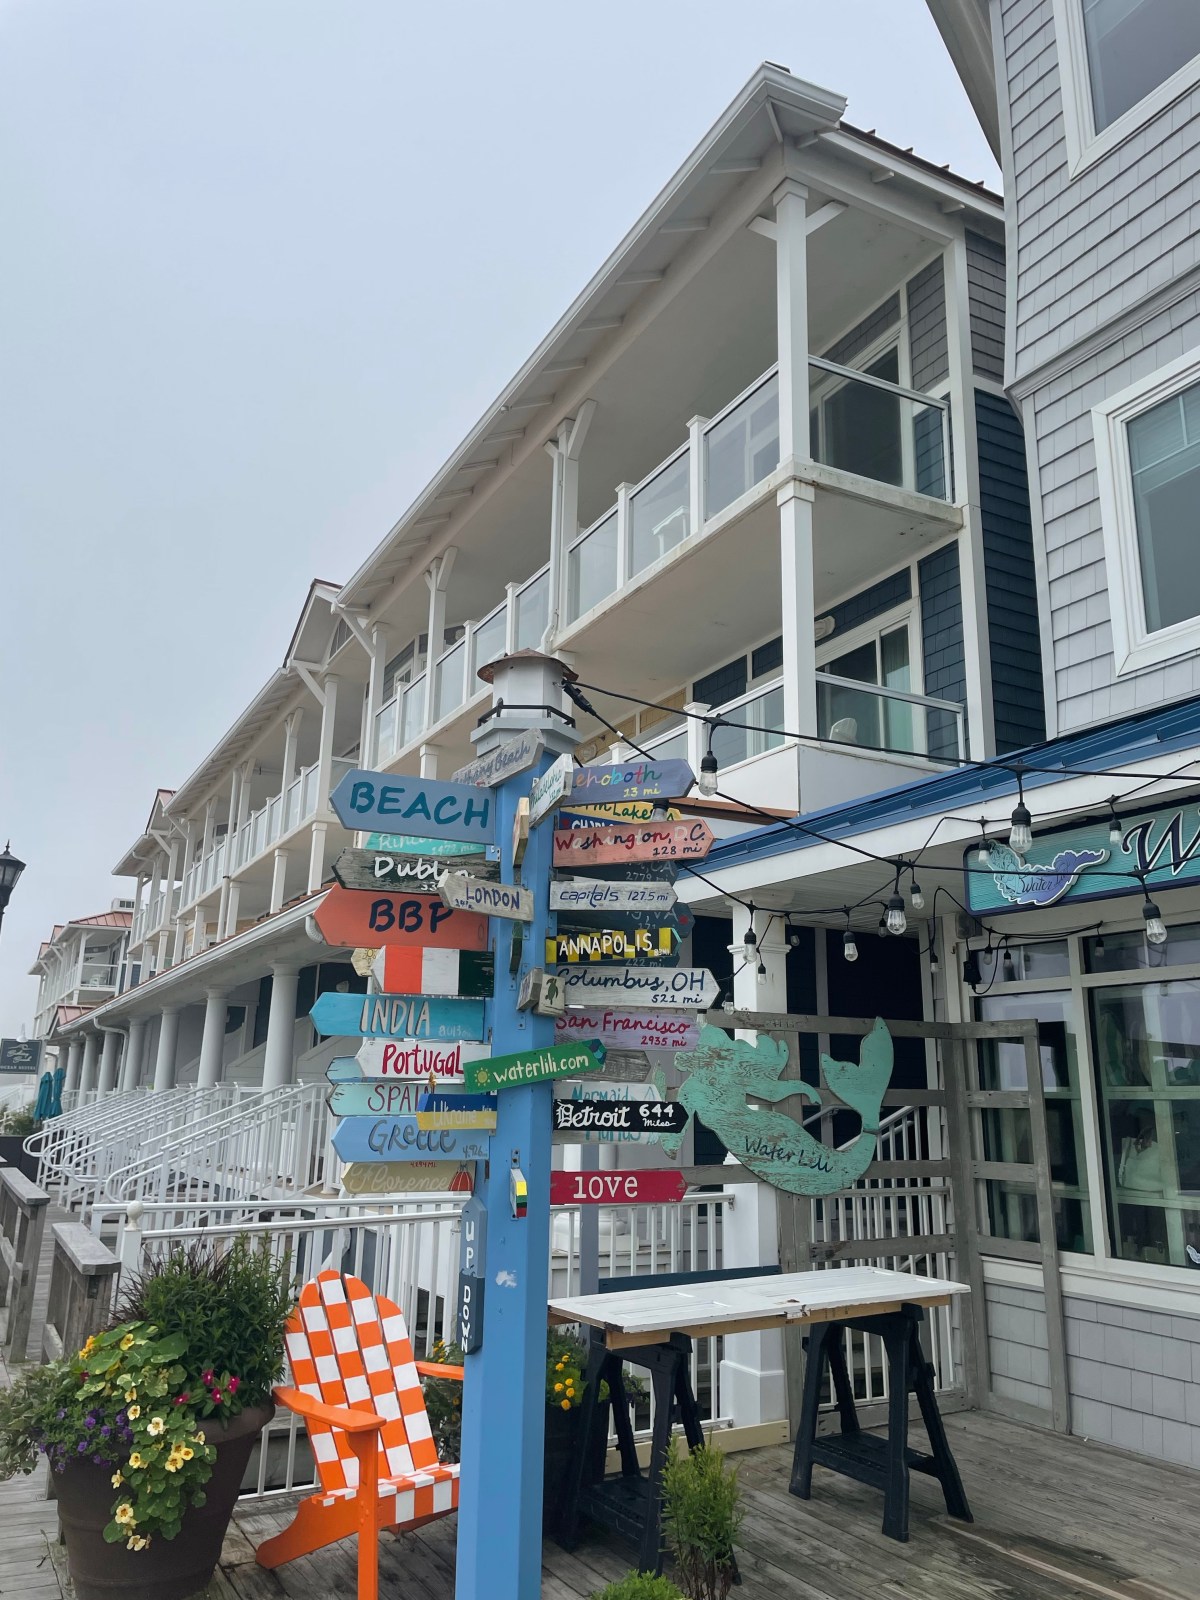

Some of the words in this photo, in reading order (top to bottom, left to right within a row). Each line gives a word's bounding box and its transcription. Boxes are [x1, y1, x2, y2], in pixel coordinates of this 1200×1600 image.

[643, 783, 661, 796] mi
[349, 781, 490, 829] BEACH
[555, 829, 671, 851] Washington,
[674, 823, 705, 842] D.C.
[653, 846, 677, 856] 128
[683, 844, 703, 854] mi
[465, 882, 520, 910] LONDON
[559, 884, 619, 907] capitals
[627, 891, 655, 901] 127.5
[656, 893, 669, 901] mi
[368, 898, 454, 933] BBP
[559, 932, 653, 956] ANNAPOLIS
[557, 968, 669, 992] Columbus,
[671, 971, 705, 991] OH
[651, 994, 677, 1003] 521
[682, 994, 703, 1004] mi
[360, 998, 430, 1036] INDIA
[556, 1011, 598, 1030] San
[602, 1012, 691, 1034] Francisco
[640, 1036, 668, 1046] 2935
[671, 1036, 687, 1047] mi
[493, 1053, 589, 1084] waterlili.com
[433, 1100, 477, 1127] Ukraine
[556, 1102, 631, 1129] Detroit
[639, 1104, 674, 1118] 644
[745, 1135, 796, 1161] Water
[350, 1163, 450, 1192] Florence
[573, 1176, 638, 1200] love
[465, 1220, 475, 1269] UP
[461, 1285, 471, 1353] DOWN
